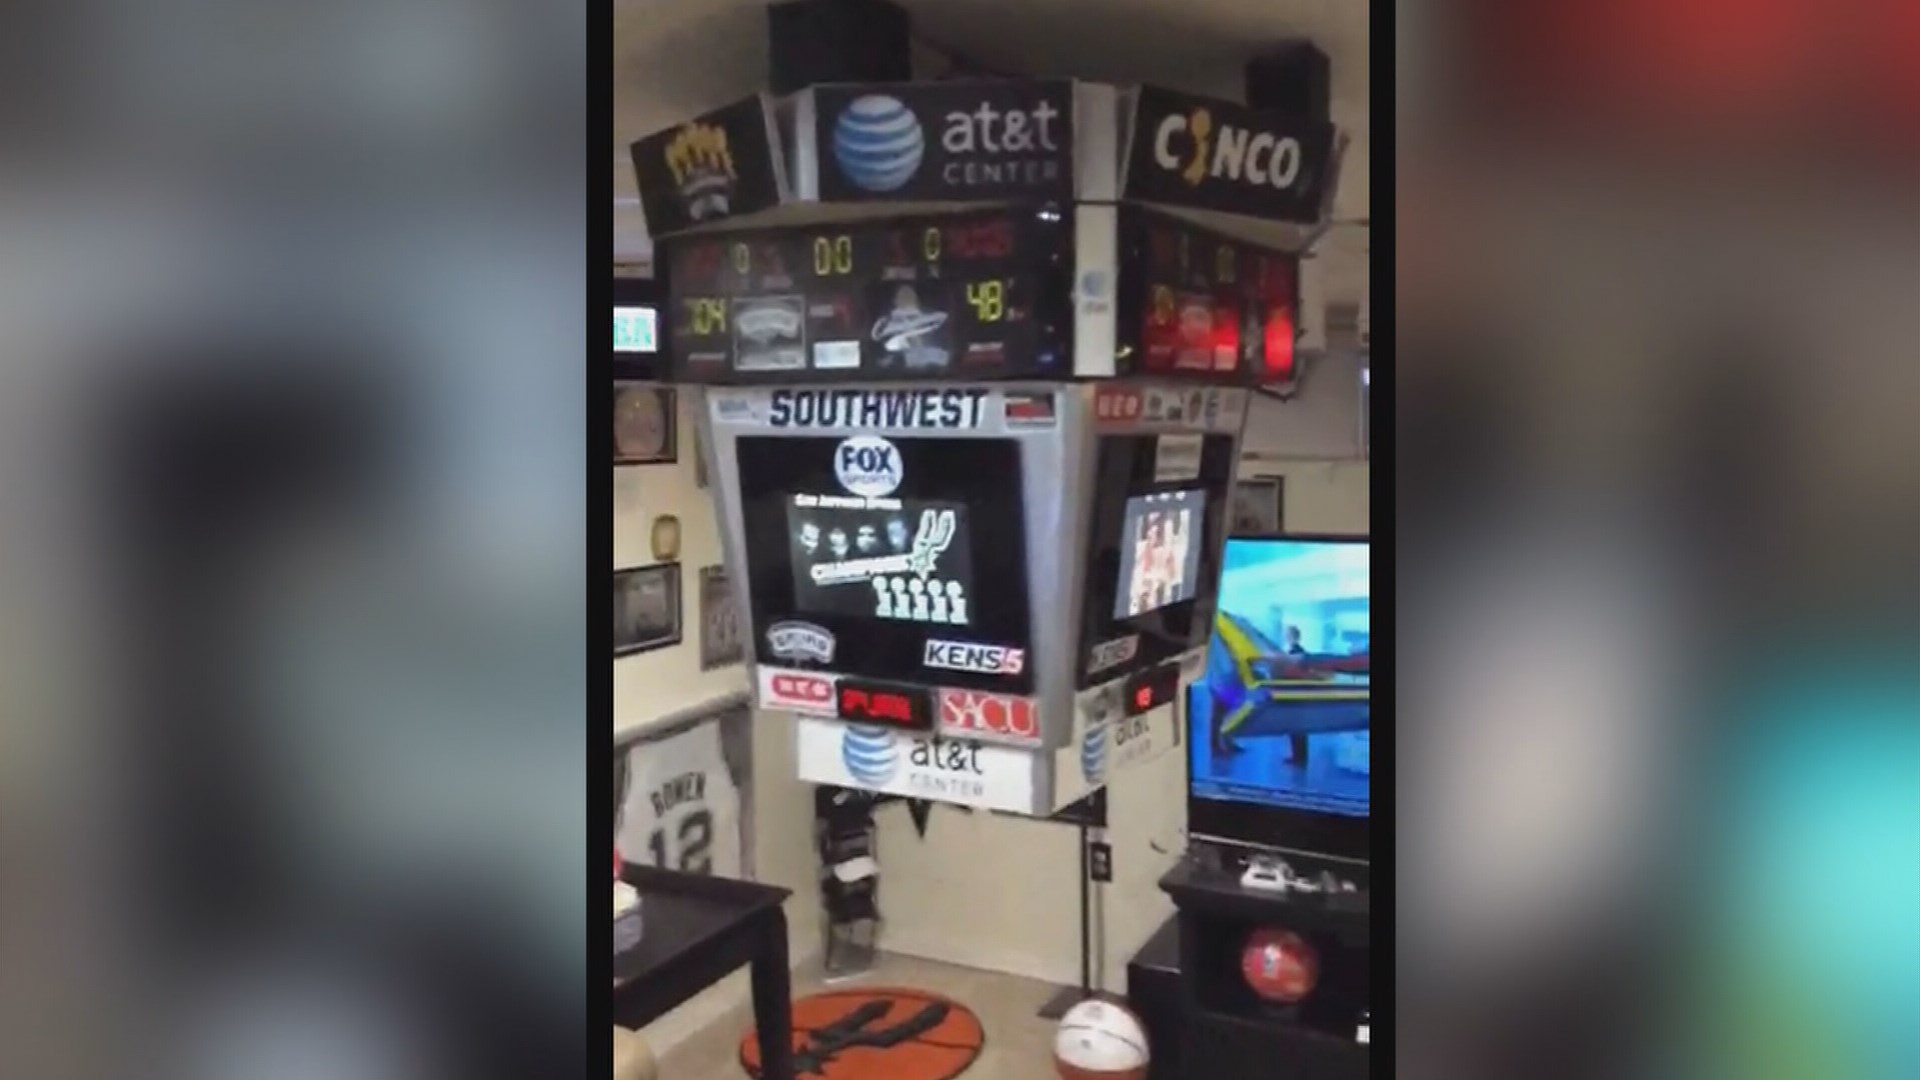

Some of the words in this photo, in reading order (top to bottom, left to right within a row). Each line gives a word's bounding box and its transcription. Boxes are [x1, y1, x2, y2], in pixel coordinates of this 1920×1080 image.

[942, 100, 1059, 153] at&t
[943, 161, 1058, 184] CENTER
[966, 280, 1003, 321] 48
[769, 389, 989, 427] SOUTHWEST
[841, 446, 895, 473] FOX
[943, 691, 1036, 736] SACU
[909, 736, 984, 776] at&t
[648, 808, 713, 874] 12
